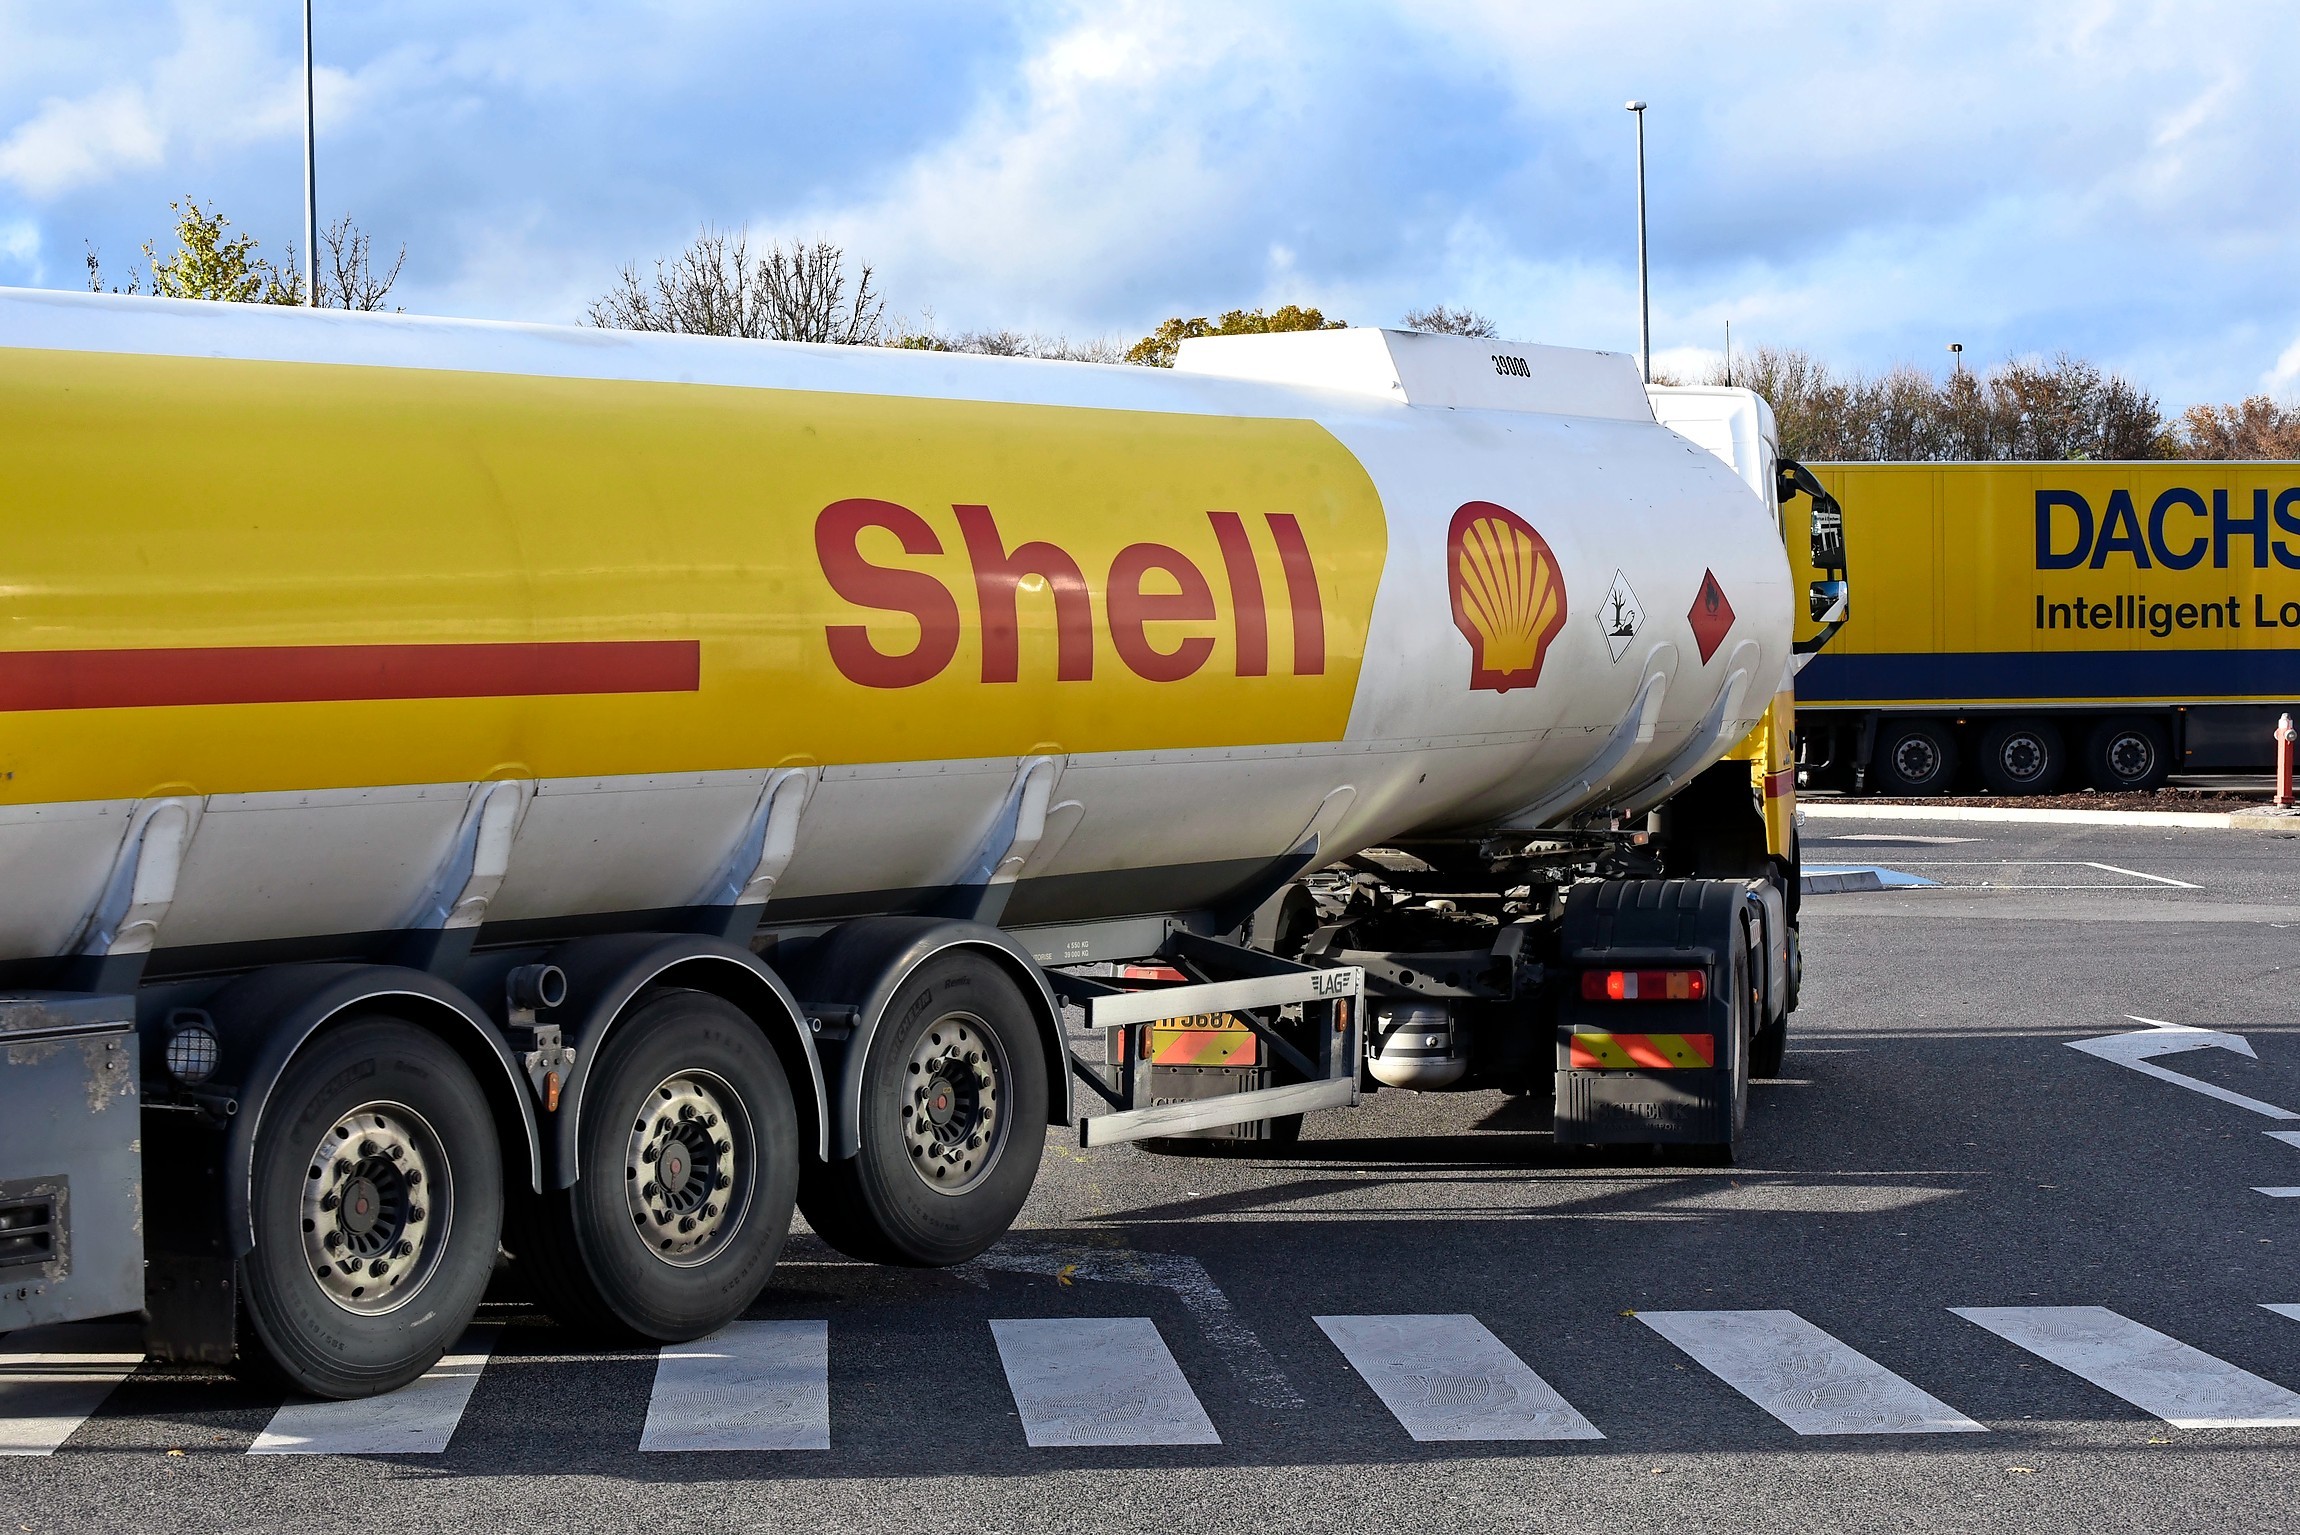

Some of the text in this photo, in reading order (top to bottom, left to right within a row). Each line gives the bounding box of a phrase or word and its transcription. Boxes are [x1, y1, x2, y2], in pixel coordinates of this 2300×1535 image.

[1491, 355, 1531, 378] 39000
[814, 497, 1326, 690] Shell
[2036, 595, 2241, 638] Intelligent
[1032, 952, 1053, 961] TORISE
[1319, 972, 1343, 995] LAG
